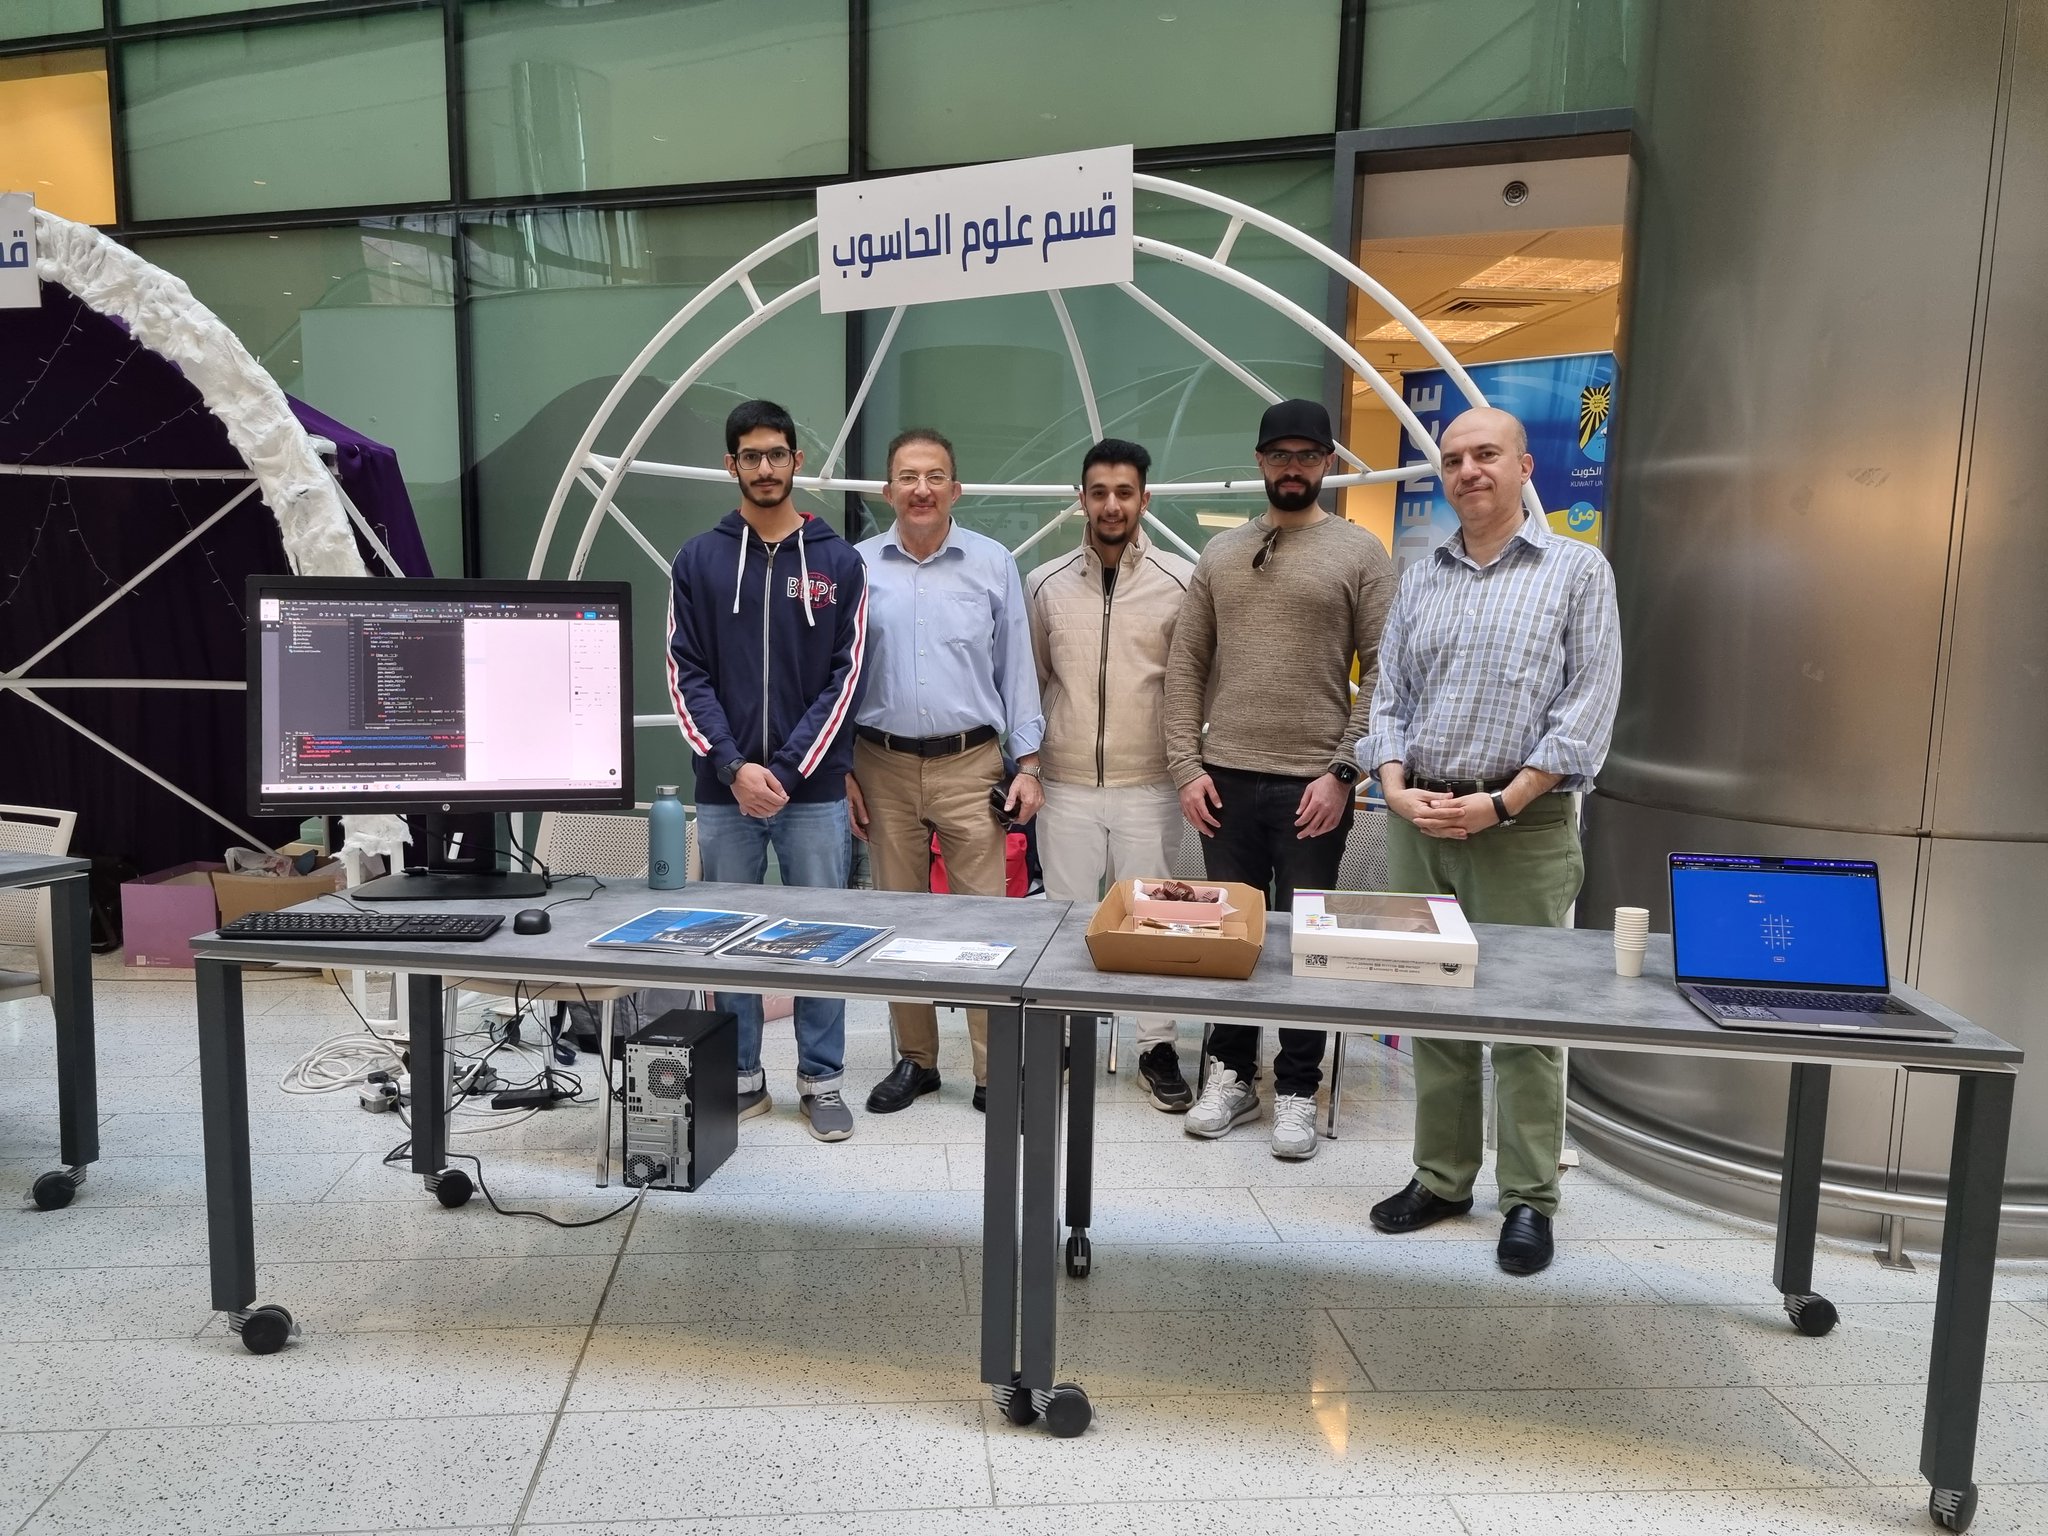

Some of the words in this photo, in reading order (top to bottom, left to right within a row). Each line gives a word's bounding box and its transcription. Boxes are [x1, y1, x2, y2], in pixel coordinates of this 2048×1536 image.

[1042, 191, 1116, 263] قسم
[832, 212, 951, 279] الحاسوب
[961, 205, 1034, 272] علوم
[1571, 466, 1602, 479] الكويت
[1570, 480, 1594, 488] KUWAIT
[1569, 508, 1595, 526] من
[657, 862, 667, 871] 24
